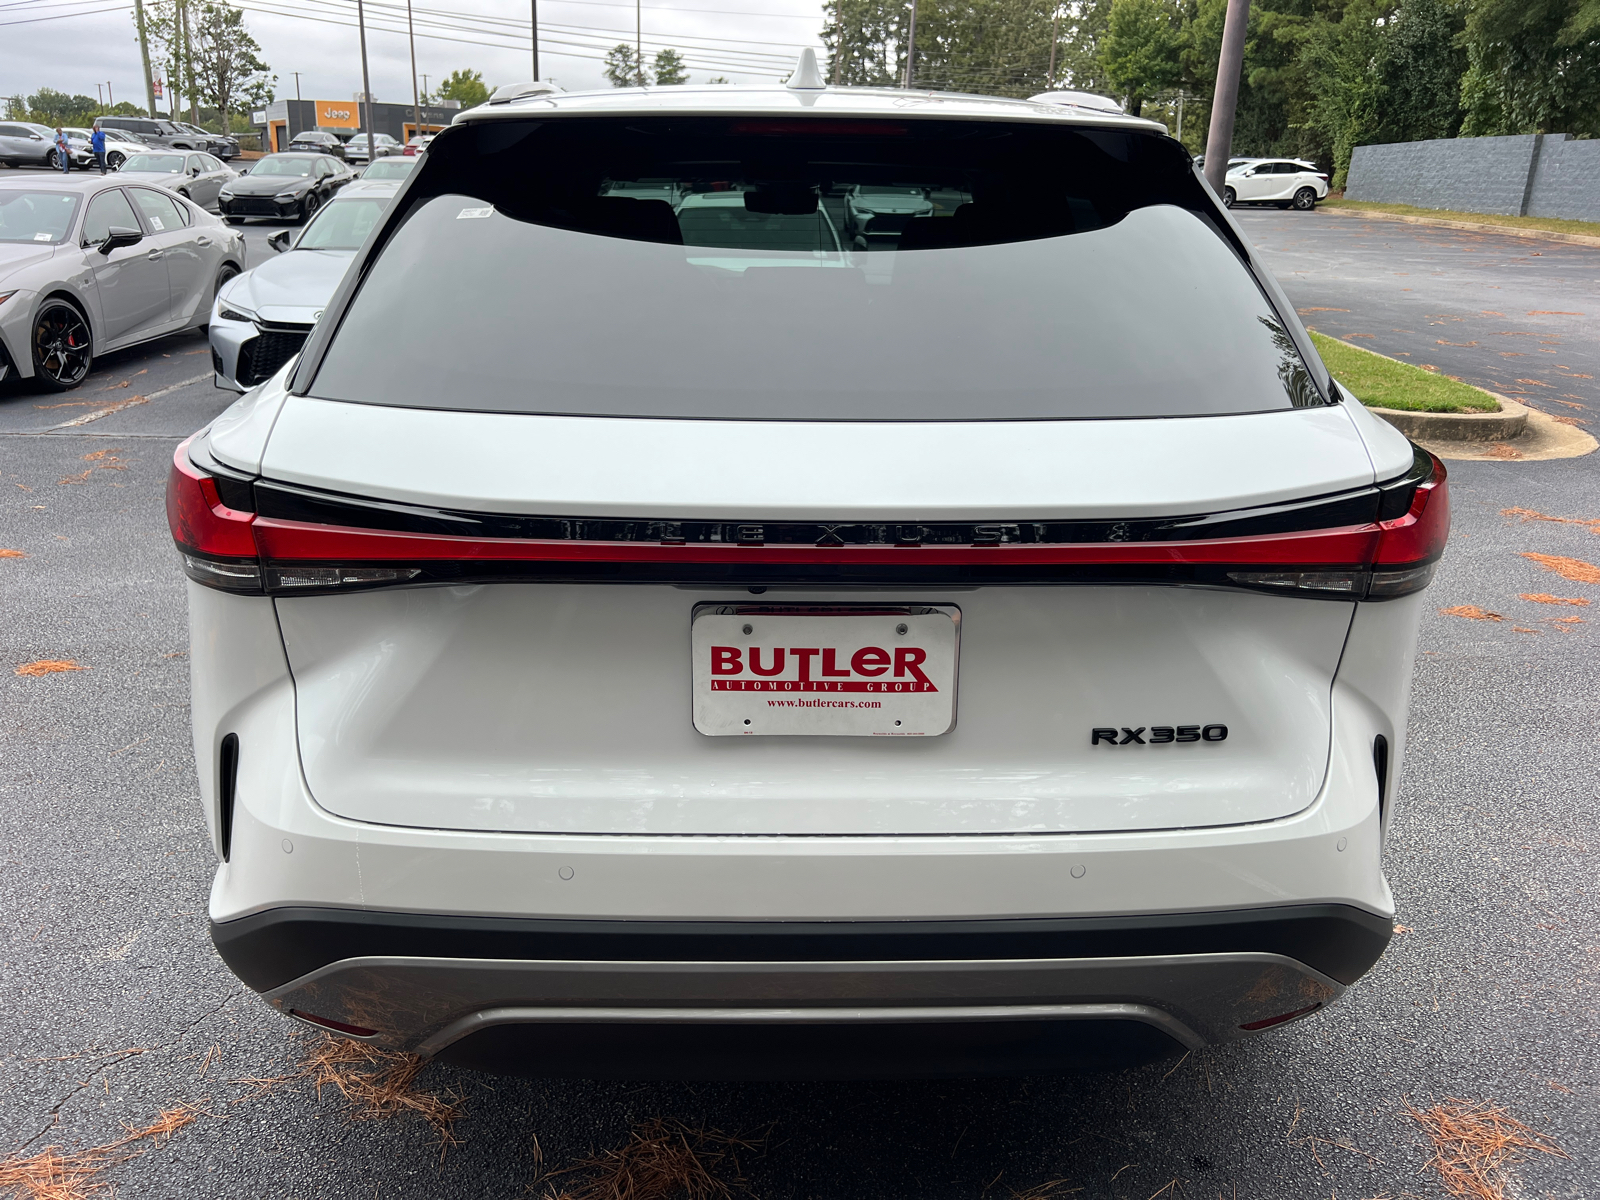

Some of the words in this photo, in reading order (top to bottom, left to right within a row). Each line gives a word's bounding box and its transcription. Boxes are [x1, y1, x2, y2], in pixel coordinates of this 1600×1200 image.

[324, 107, 350, 121] Jeep
[660, 523, 1001, 544] LEXUS
[712, 681, 844, 691] AUTOMOTIVE
[866, 682, 930, 692] GROUP
[767, 698, 882, 709] www.butlercars.com
